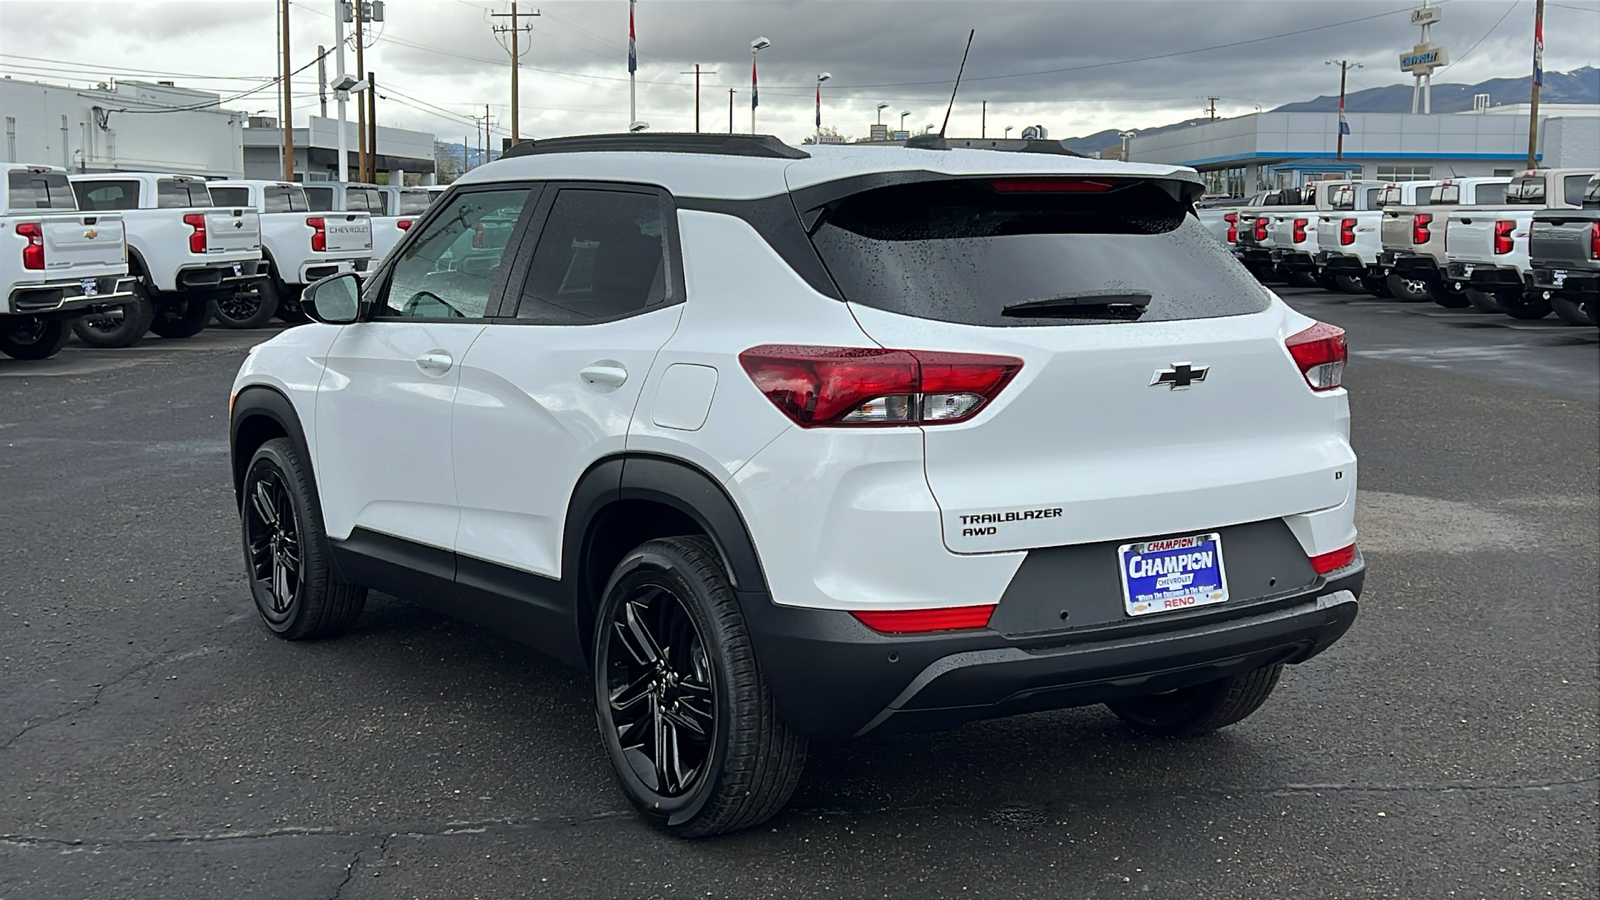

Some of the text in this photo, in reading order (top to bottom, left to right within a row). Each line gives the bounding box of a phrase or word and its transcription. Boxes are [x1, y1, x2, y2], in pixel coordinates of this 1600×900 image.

[329, 226, 369, 234] CHEVROLET
[959, 508, 1063, 525] TRAILBLAZER
[962, 526, 997, 537] AWD
[1147, 537, 1194, 552] CHAMPION
[1129, 550, 1213, 579] CHAMPION
[1157, 575, 1191, 587] CHEVROLET
[1163, 589, 1185, 598] Customer
[1164, 596, 1195, 608] RENO
